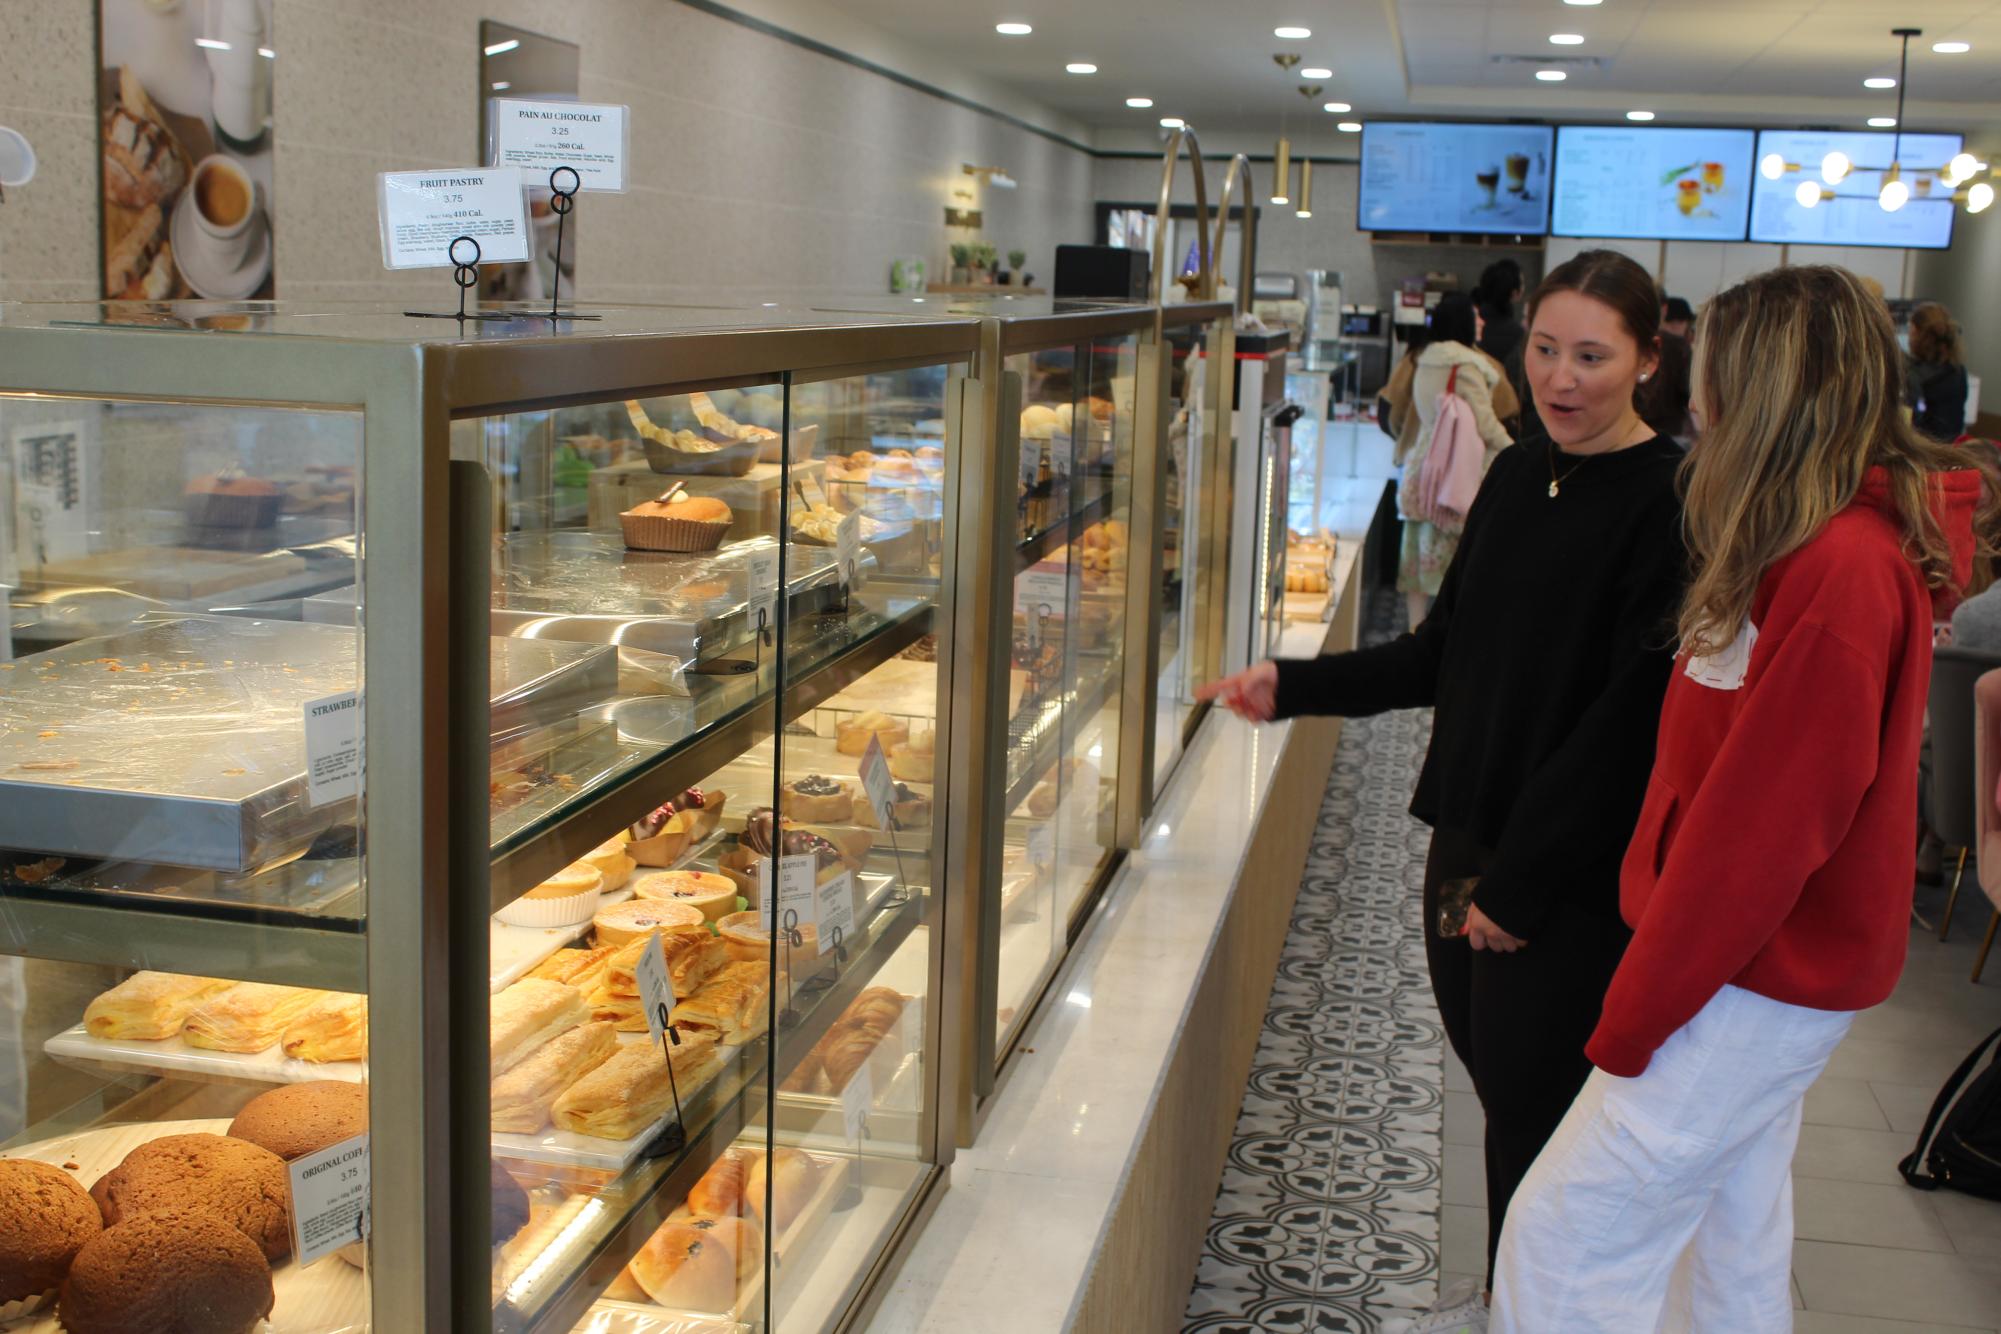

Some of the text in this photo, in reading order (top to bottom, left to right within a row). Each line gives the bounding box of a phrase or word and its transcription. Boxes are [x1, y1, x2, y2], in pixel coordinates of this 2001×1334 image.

[518, 110, 602, 123] PAIN AU CHOCOLAT
[551, 127, 569, 136] 3.25
[557, 142, 571, 150] 260
[420, 177, 485, 188] FRUIT PASTRY
[444, 194, 464, 204] 3.75
[453, 210, 467, 218] 410
[302, 1156, 341, 1180] ORIGINAL
[341, 1168, 359, 1182] 3.75
